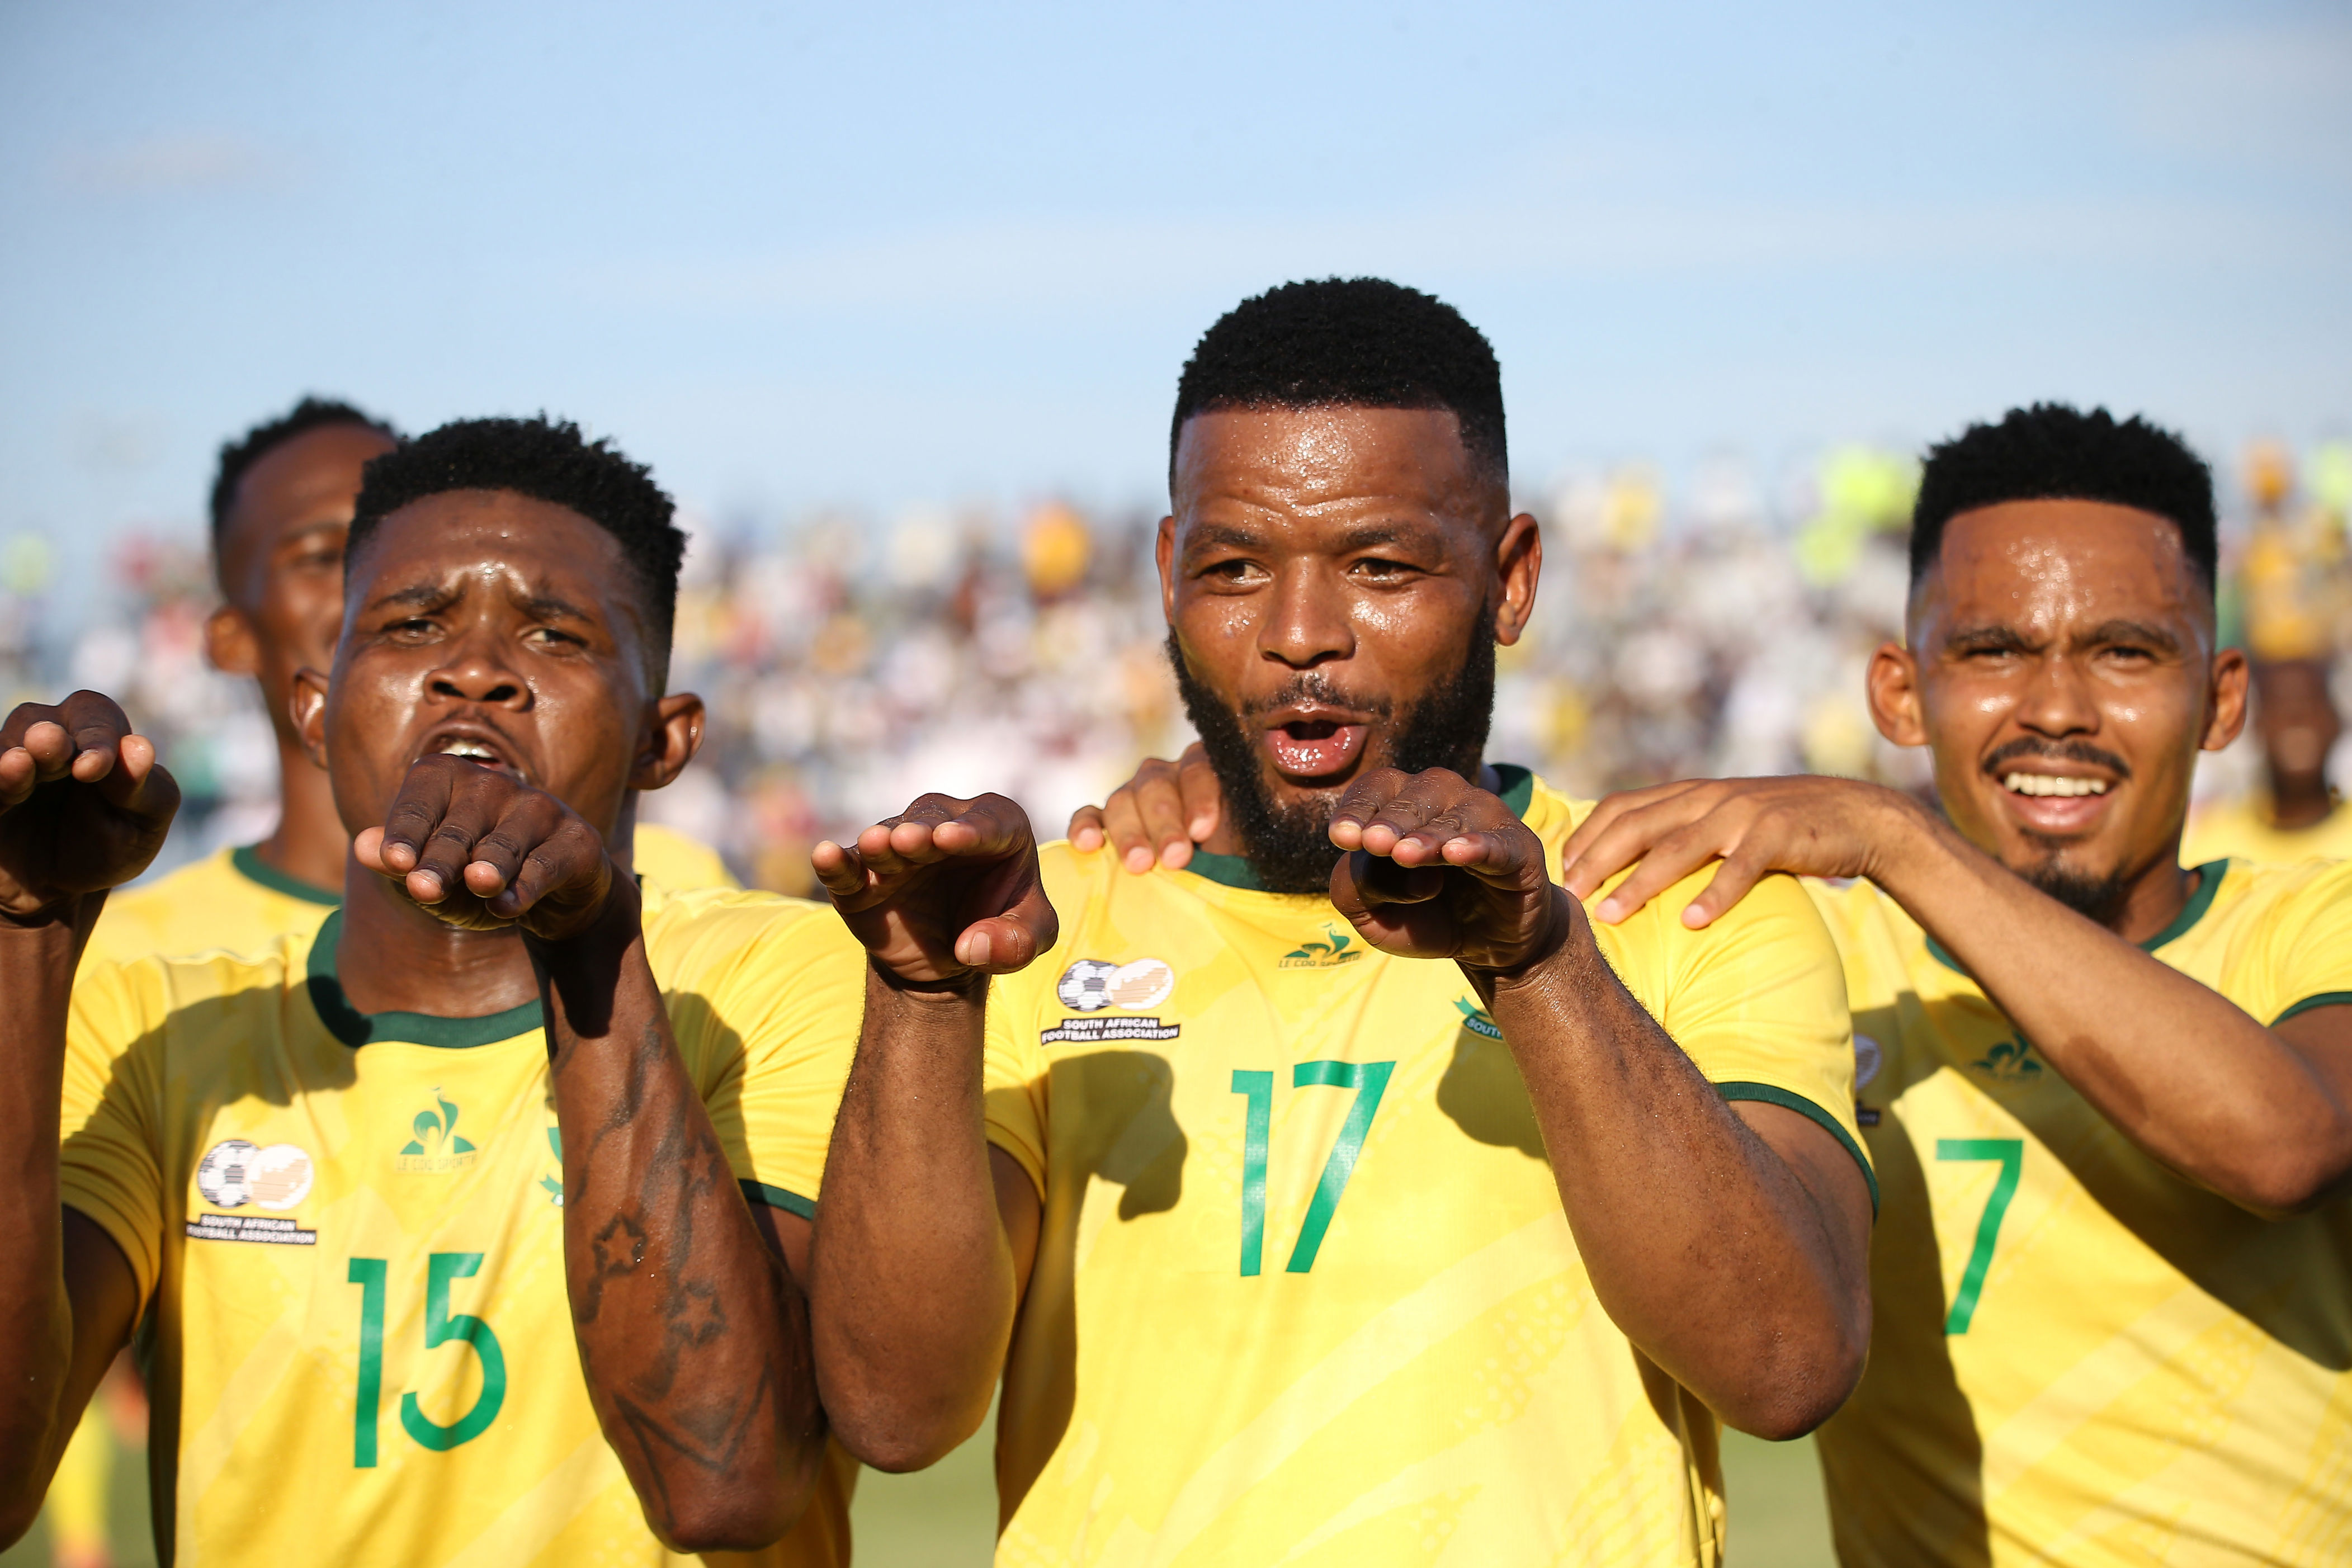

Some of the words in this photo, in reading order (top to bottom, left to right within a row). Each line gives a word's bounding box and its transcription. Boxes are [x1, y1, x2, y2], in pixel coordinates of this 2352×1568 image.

[1041, 1029, 1101, 1044] FOOTBALL
[1102, 1027, 1179, 1040] ASSOCIATION
[1063, 1019, 1104, 1030] SOUTH
[1105, 1018, 1158, 1029] AFRICAN
[1230, 1060, 1396, 1277] 17
[242, 1217, 296, 1231] AFRICAN
[1935, 1139, 2024, 1335] 7
[347, 1251, 507, 1469] 15
